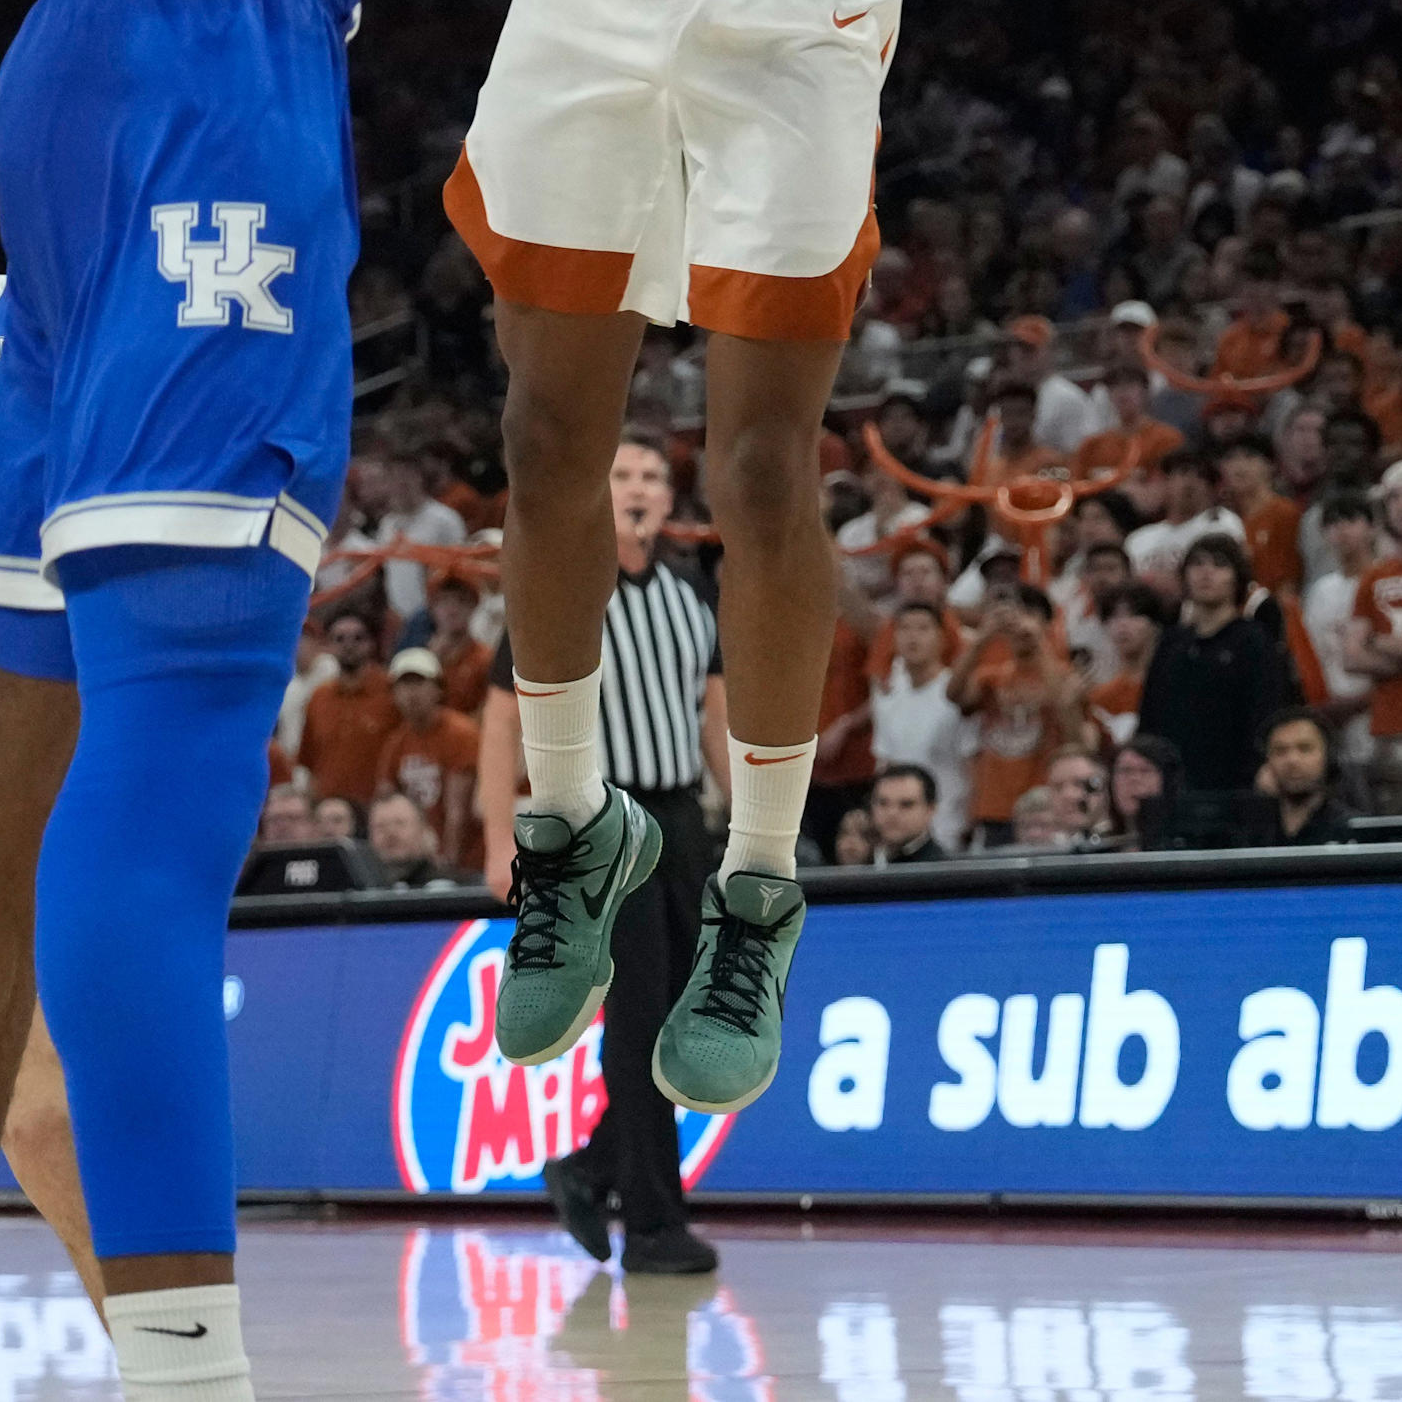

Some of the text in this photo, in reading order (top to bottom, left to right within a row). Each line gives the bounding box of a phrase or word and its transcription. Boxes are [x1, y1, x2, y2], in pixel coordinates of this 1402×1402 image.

[150, 200, 296, 335] UK
[807, 996, 892, 1133] a
[927, 942, 1181, 1133] sub
